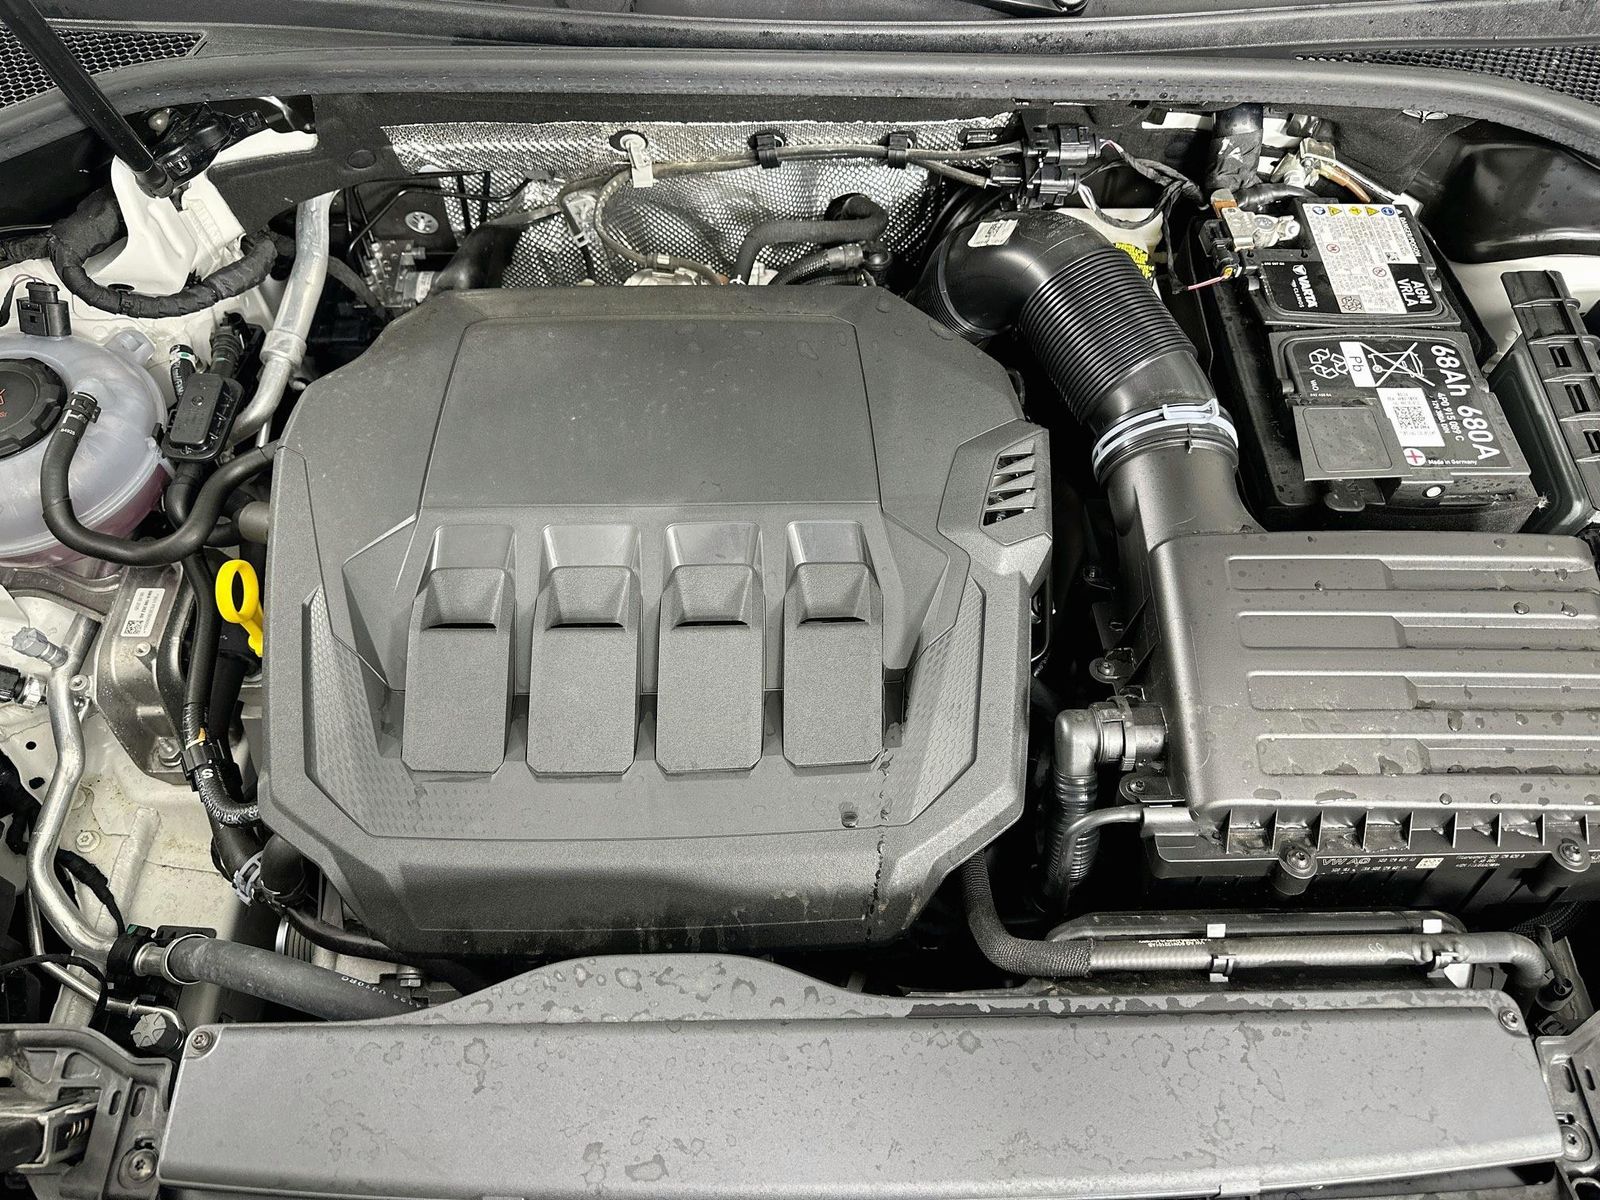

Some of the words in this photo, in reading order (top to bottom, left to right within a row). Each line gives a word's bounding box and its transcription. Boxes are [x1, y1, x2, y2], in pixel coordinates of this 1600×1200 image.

[1298, 275, 1318, 308] VARTA
[1397, 278, 1419, 307] VRLA
[1411, 280, 1433, 304] AGM
[1349, 356, 1364, 372] Pb
[1430, 345, 1471, 396] 68Ah
[1457, 405, 1501, 460] 680A
[1443, 406, 1456, 421] 915
[1322, 857, 1348, 866] VW
